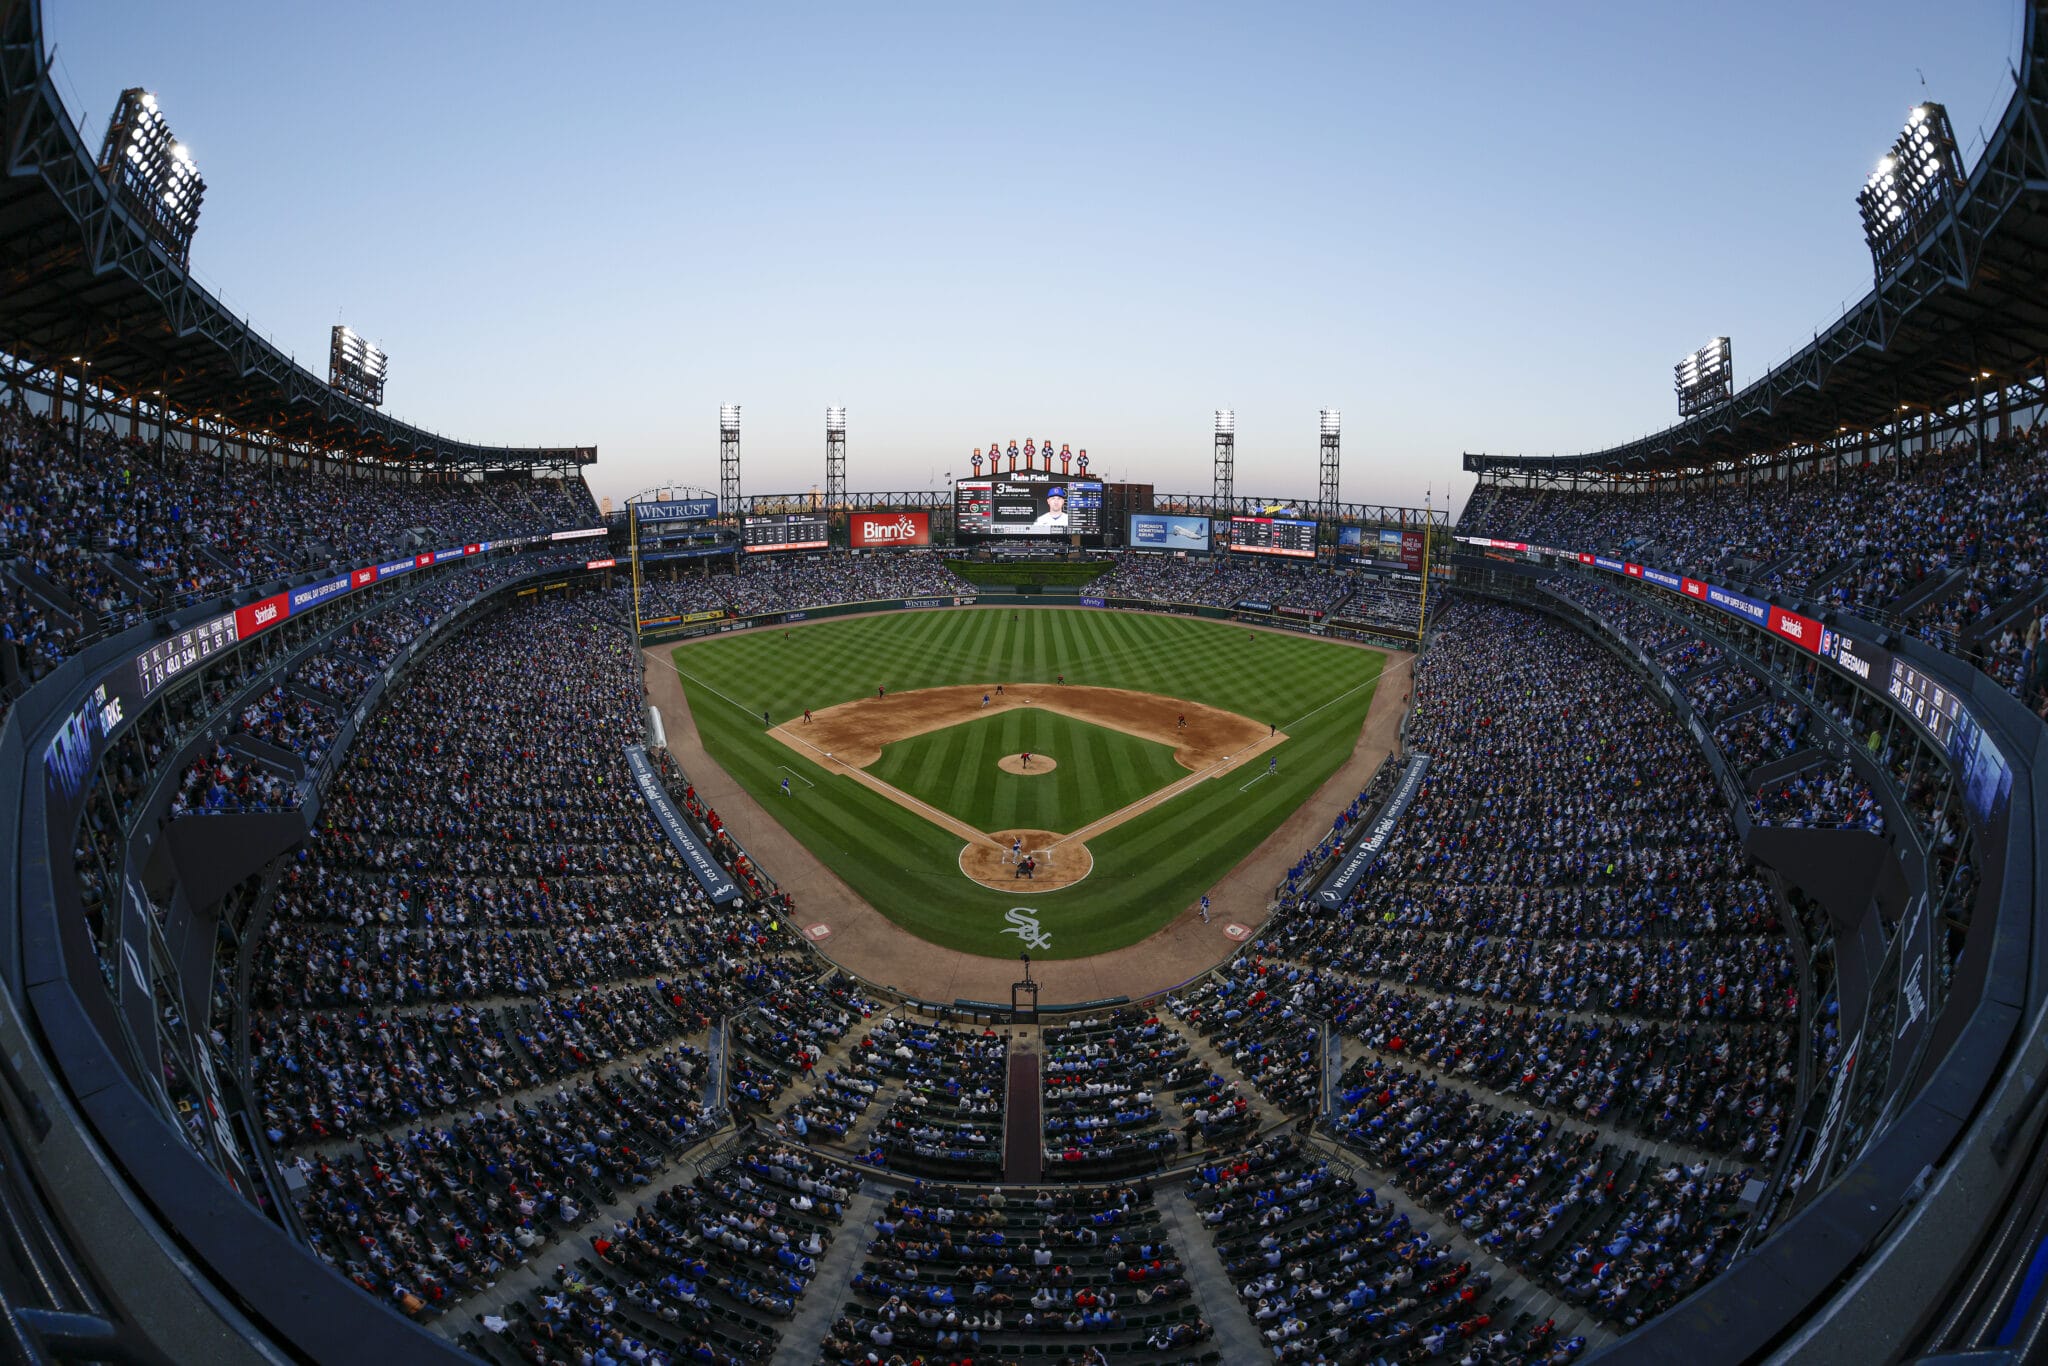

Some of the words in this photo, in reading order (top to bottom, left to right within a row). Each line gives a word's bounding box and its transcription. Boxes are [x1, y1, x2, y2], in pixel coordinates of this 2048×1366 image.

[1011, 472, 1029, 481] Rate
[996, 484, 1005, 493] 3
[181, 633, 193, 647] ERA
[198, 626, 210, 639] BALL
[1841, 637, 1853, 651] ALEX
[201, 640, 210, 655] 21
[1831, 633, 1840, 659] 3
[1839, 649, 1870, 679] BREGMAN
[1374, 818, 1395, 836] Field
[668, 818, 679, 829] THE
[674, 827, 695, 851] CHICAGO
[690, 848, 709, 869] WHITE
[704, 868, 720, 882] SOX
[1360, 835, 1385, 852] Rate
[1356, 851, 1367, 860] TO
[1333, 858, 1362, 888] WELCOME
